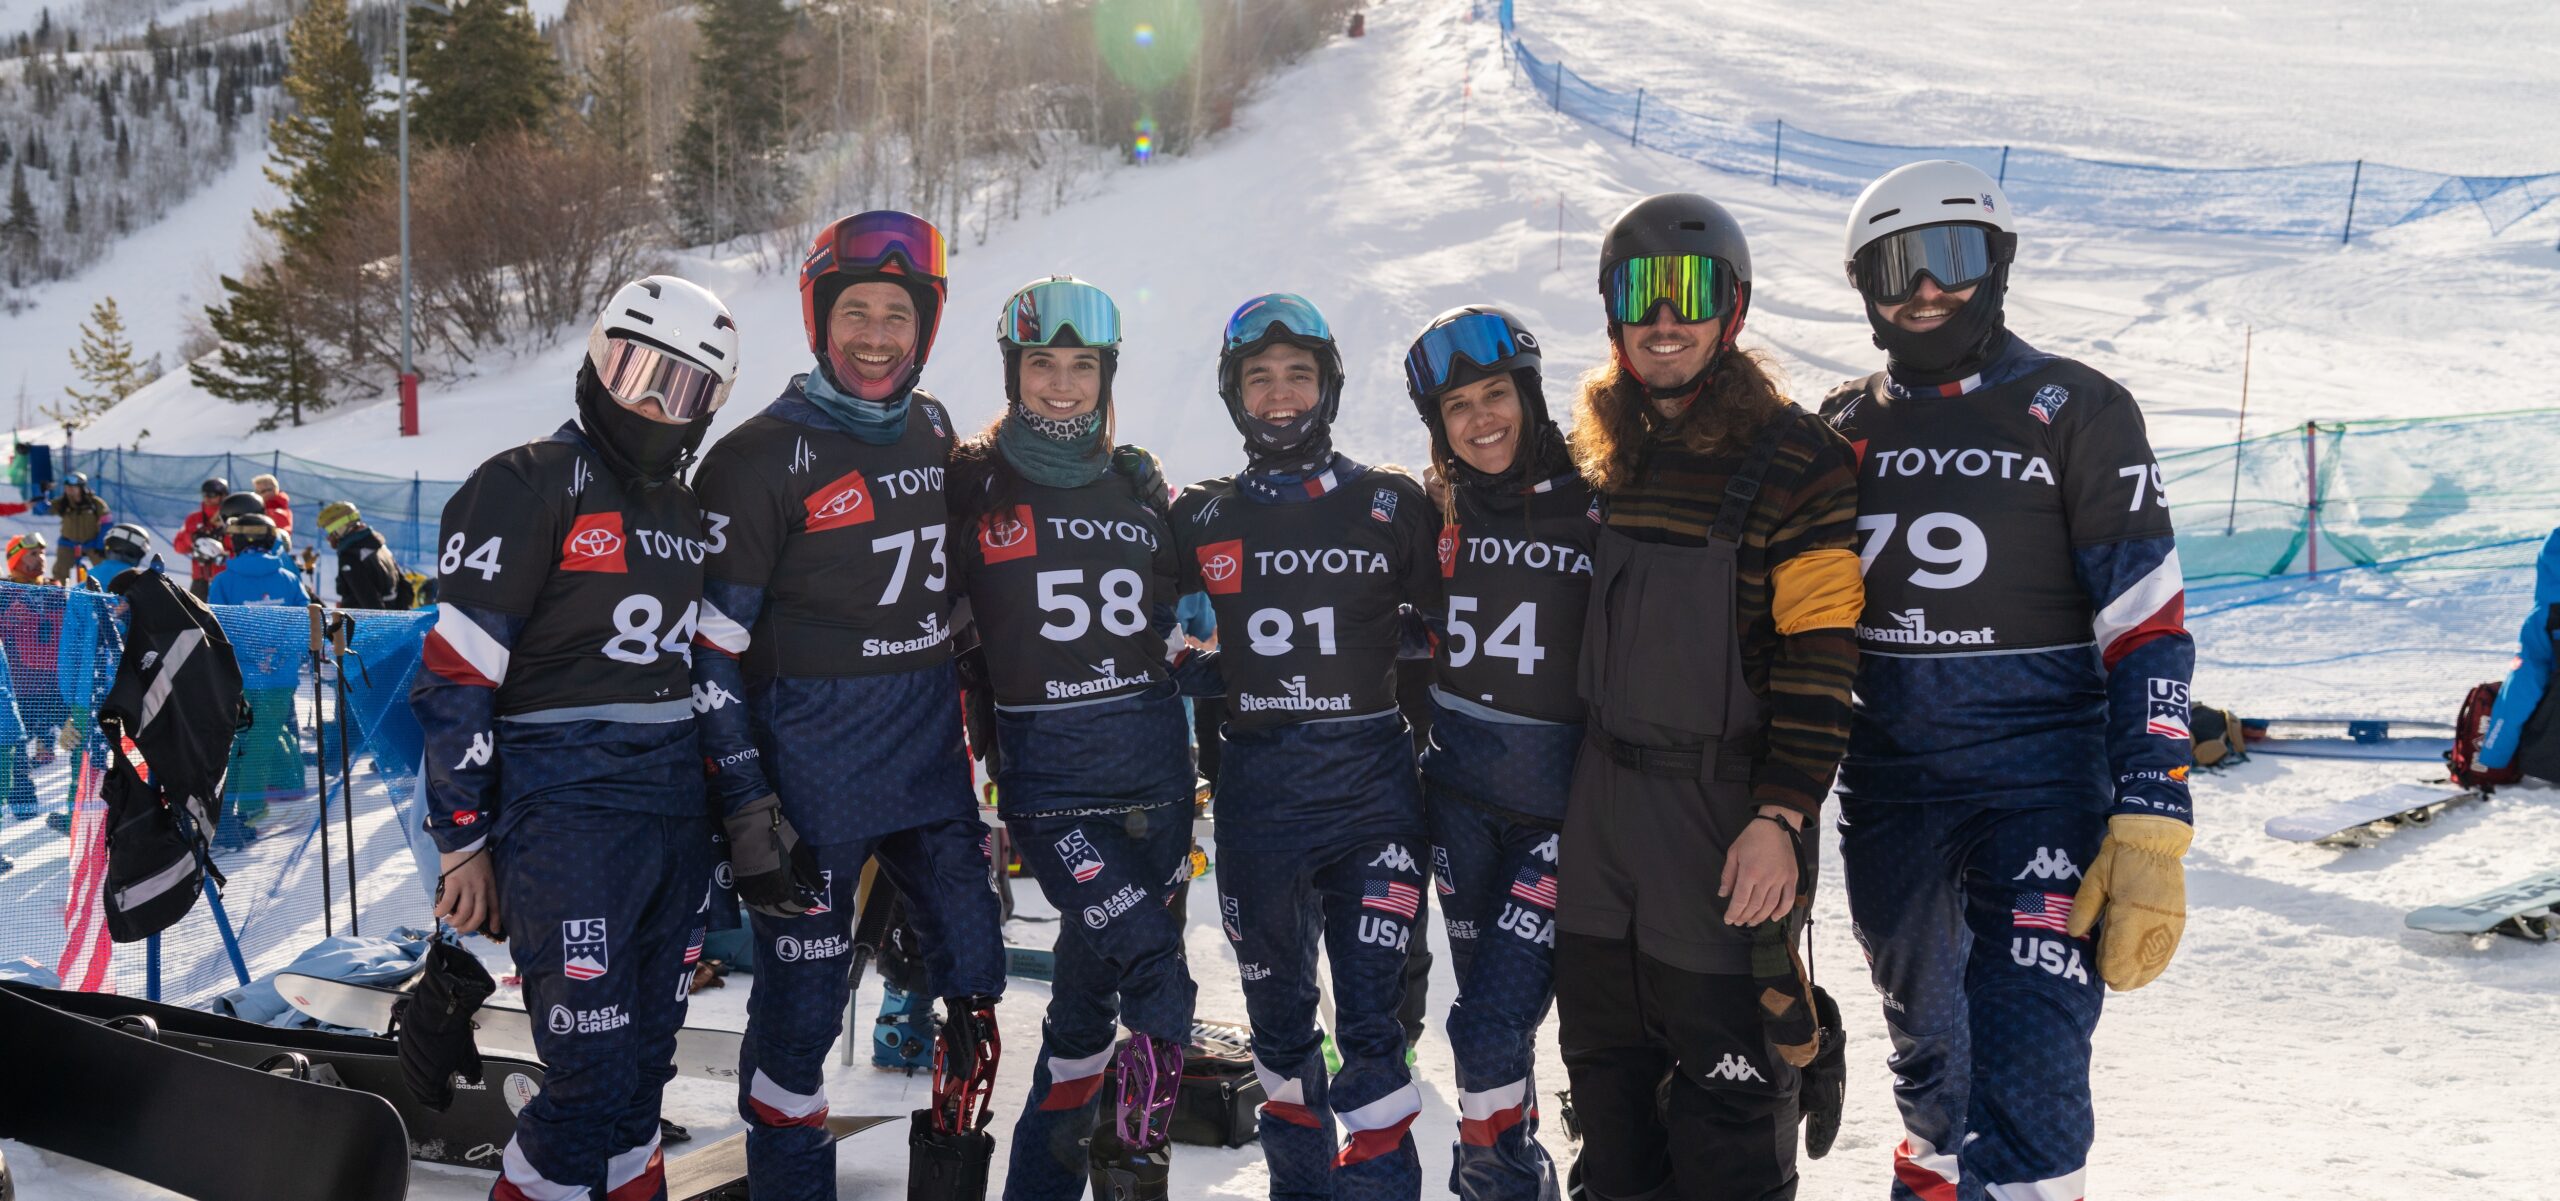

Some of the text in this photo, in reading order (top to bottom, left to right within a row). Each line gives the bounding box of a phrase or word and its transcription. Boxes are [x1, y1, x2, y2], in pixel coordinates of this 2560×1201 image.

[2040, 387, 2066, 406] US
[1875, 447, 2056, 486] TOYOTA
[877, 467, 946, 500] TOYOT
[2118, 463, 2169, 512] 79
[1192, 495, 1223, 527] FIS
[635, 528, 705, 564] TOYO
[700, 509, 731, 554] 3
[439, 531, 503, 582] 84
[871, 523, 947, 607] 73
[1254, 548, 1390, 577] TOYOTA
[1467, 536, 1594, 577] TOYOTA
[1856, 511, 1988, 590] 79
[1036, 568, 1148, 642] 58
[601, 593, 698, 670] 84
[862, 616, 951, 657] Steamboa
[1247, 606, 1338, 657] 81
[1446, 594, 1546, 676] 54
[1240, 681, 1352, 712] Steamboat
[2149, 679, 2189, 702] US
[717, 747, 760, 768] TOYOTA
[1056, 830, 1087, 857] US
[1103, 883, 1134, 911] EASY
[1109, 887, 1148, 918] GREEN
[564, 919, 605, 943] US
[1358, 915, 1411, 954] USA
[1448, 928, 1481, 940] GREE
[1497, 902, 1556, 949] USA
[803, 939, 850, 961] GREEN
[804, 934, 841, 951] EASY
[1240, 962, 1260, 974] ASY
[2010, 936, 2088, 986] USA
[577, 1003, 619, 1022] EASY
[577, 1012, 630, 1034] GREEN
